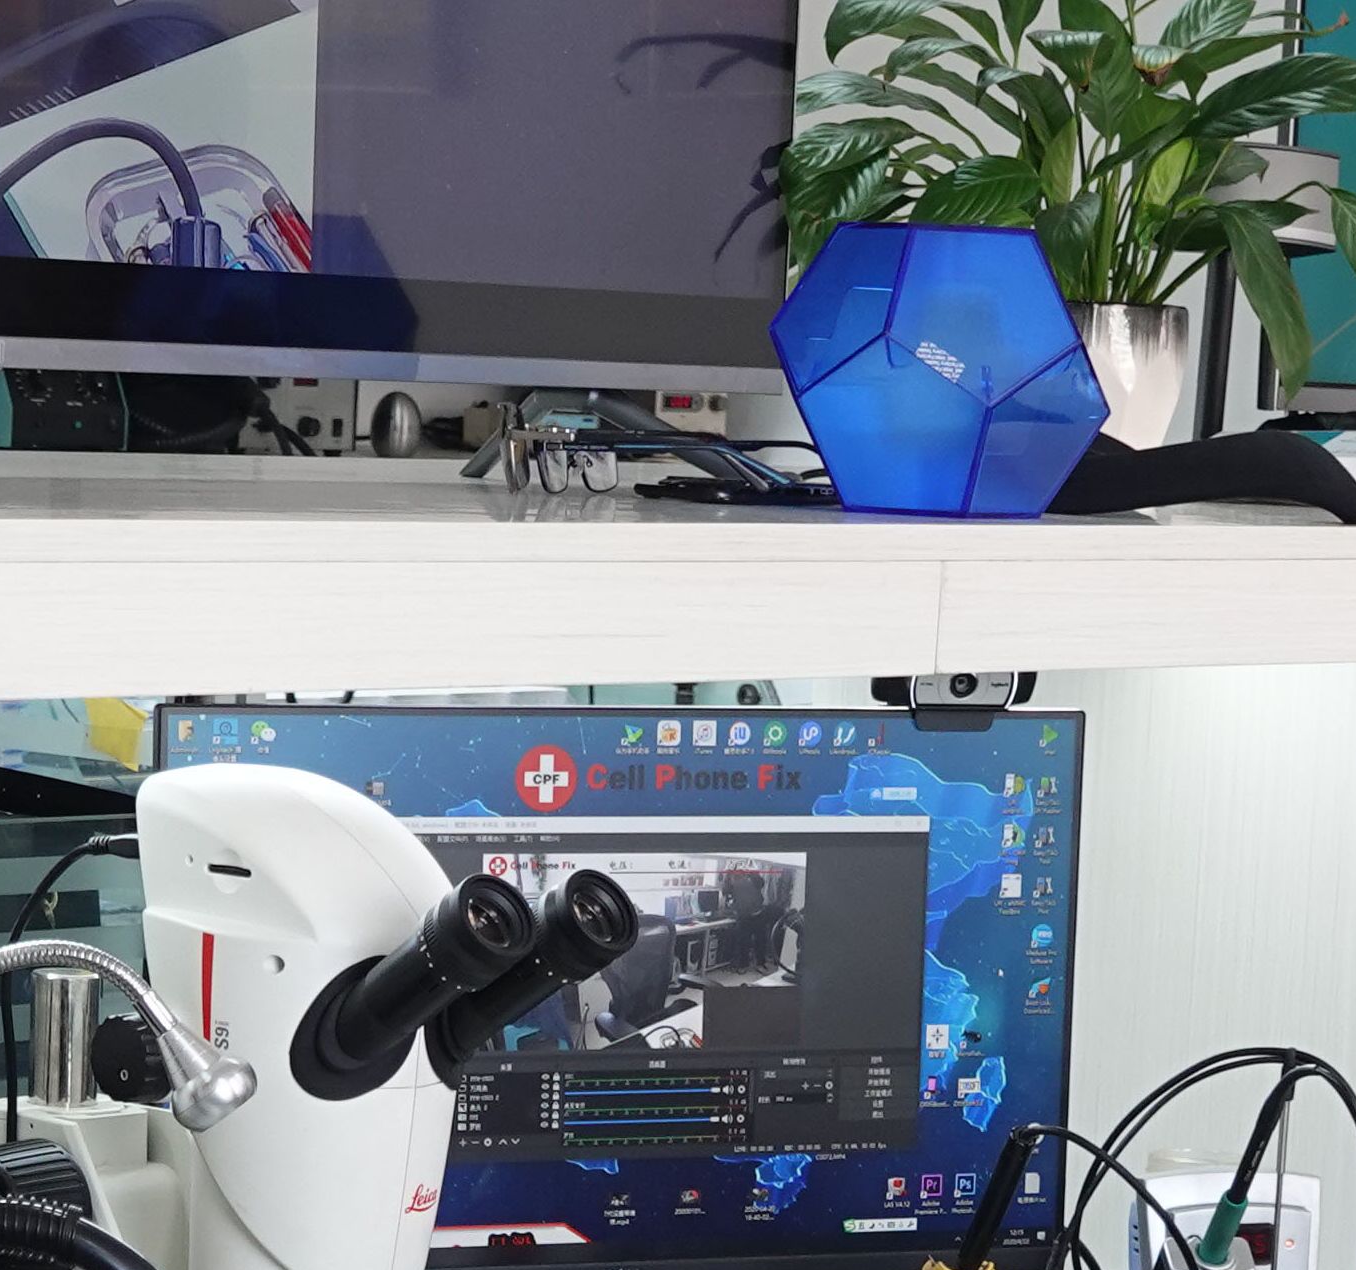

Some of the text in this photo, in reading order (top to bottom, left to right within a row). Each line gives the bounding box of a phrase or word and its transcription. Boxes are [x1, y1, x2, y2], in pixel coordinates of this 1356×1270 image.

[532, 774, 561, 785] CPF
[587, 763, 801, 790] Cell Phone Fix
[215, 1020, 229, 1050] S9i
[926, 1179, 938, 1190] Pr
[959, 1178, 972, 1190] Ps
[405, 1184, 438, 1214] Leica
